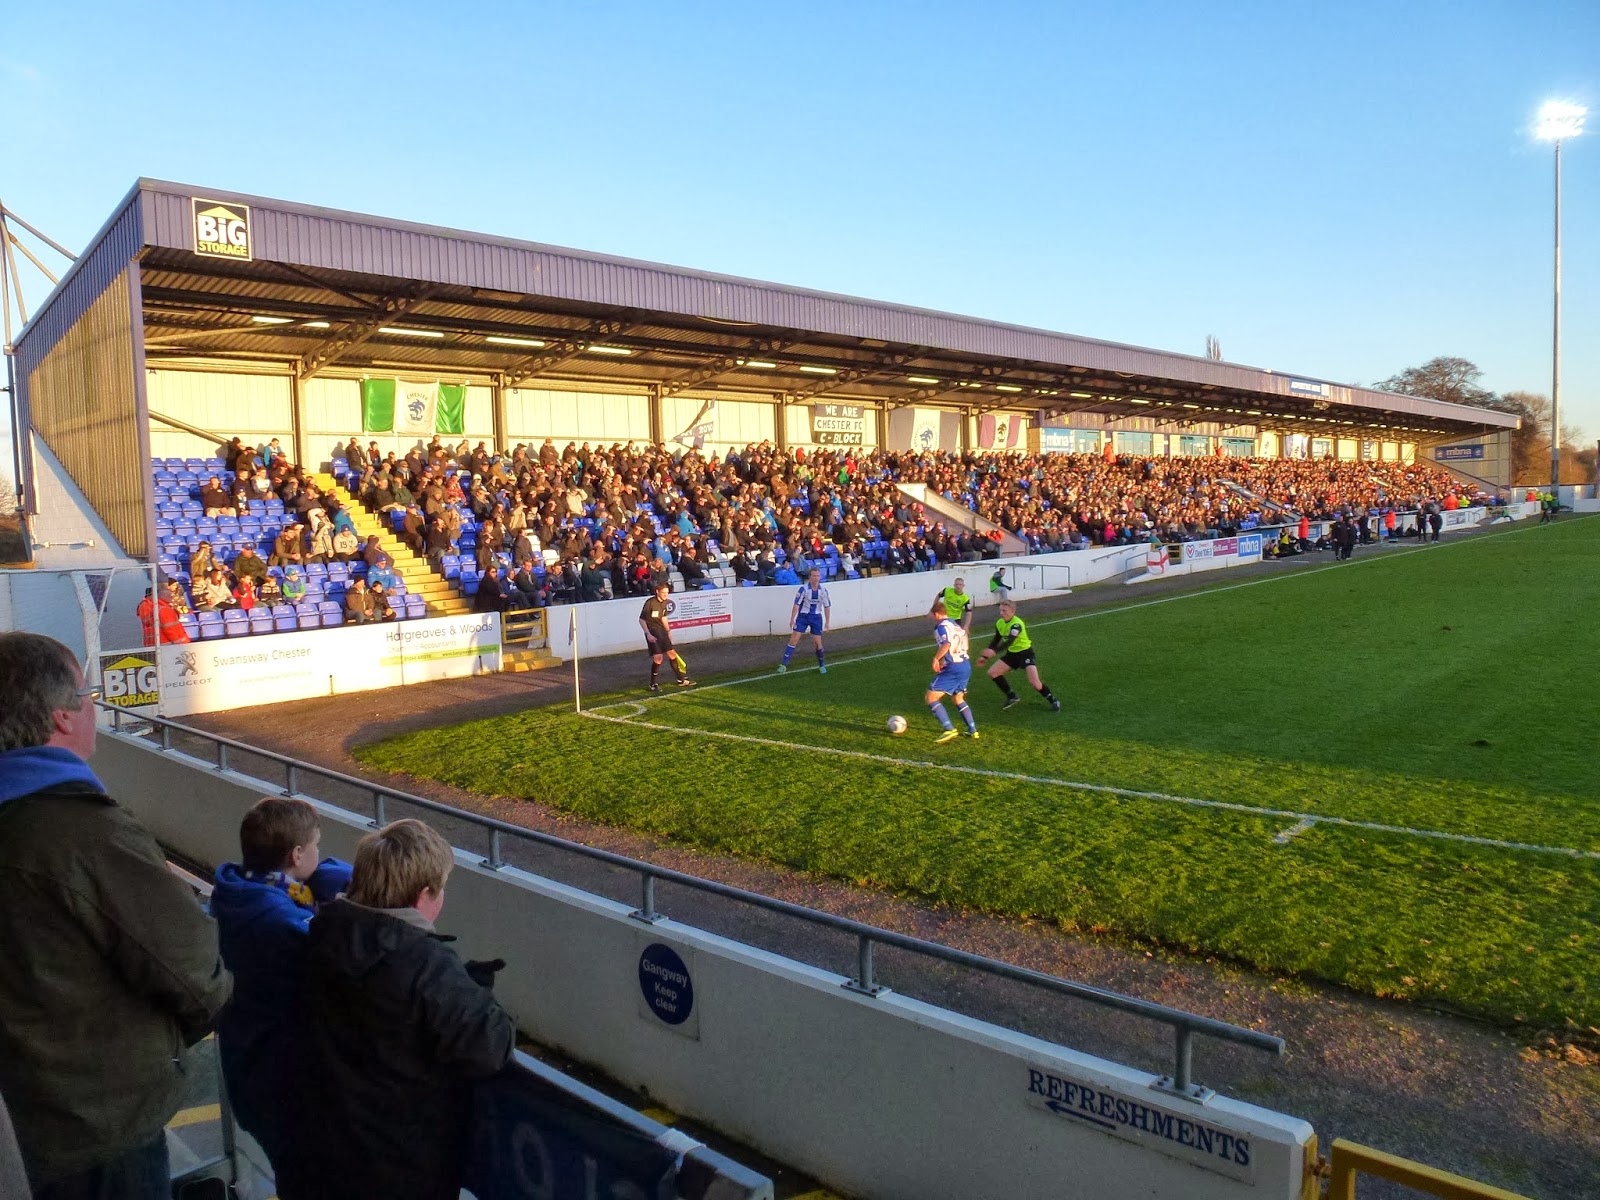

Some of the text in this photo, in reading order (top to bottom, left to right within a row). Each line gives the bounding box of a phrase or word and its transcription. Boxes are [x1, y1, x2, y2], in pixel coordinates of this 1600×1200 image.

[197, 214, 247, 247] BiG
[199, 241, 248, 257] STORAGE
[407, 392, 428, 401] CHESTER
[825, 405, 858, 417] WE ARE
[817, 419, 862, 430] CHESTER FC
[833, 433, 861, 444] BLOCK
[1046, 432, 1069, 447] mbna
[1446, 448, 1472, 456] mbna
[1240, 537, 1259, 553] mbna
[386, 623, 493, 642] Hargreaves & Woods
[213, 647, 311, 668] Swansway Chester
[104, 665, 158, 698] BiG
[165, 678, 212, 689] PEUGEOT
[105, 691, 158, 707] STORAGE
[642, 959, 688, 988] Gangway
[654, 981, 678, 1001] Keep
[1028, 1068, 1250, 1166] REFRESHMENTS
